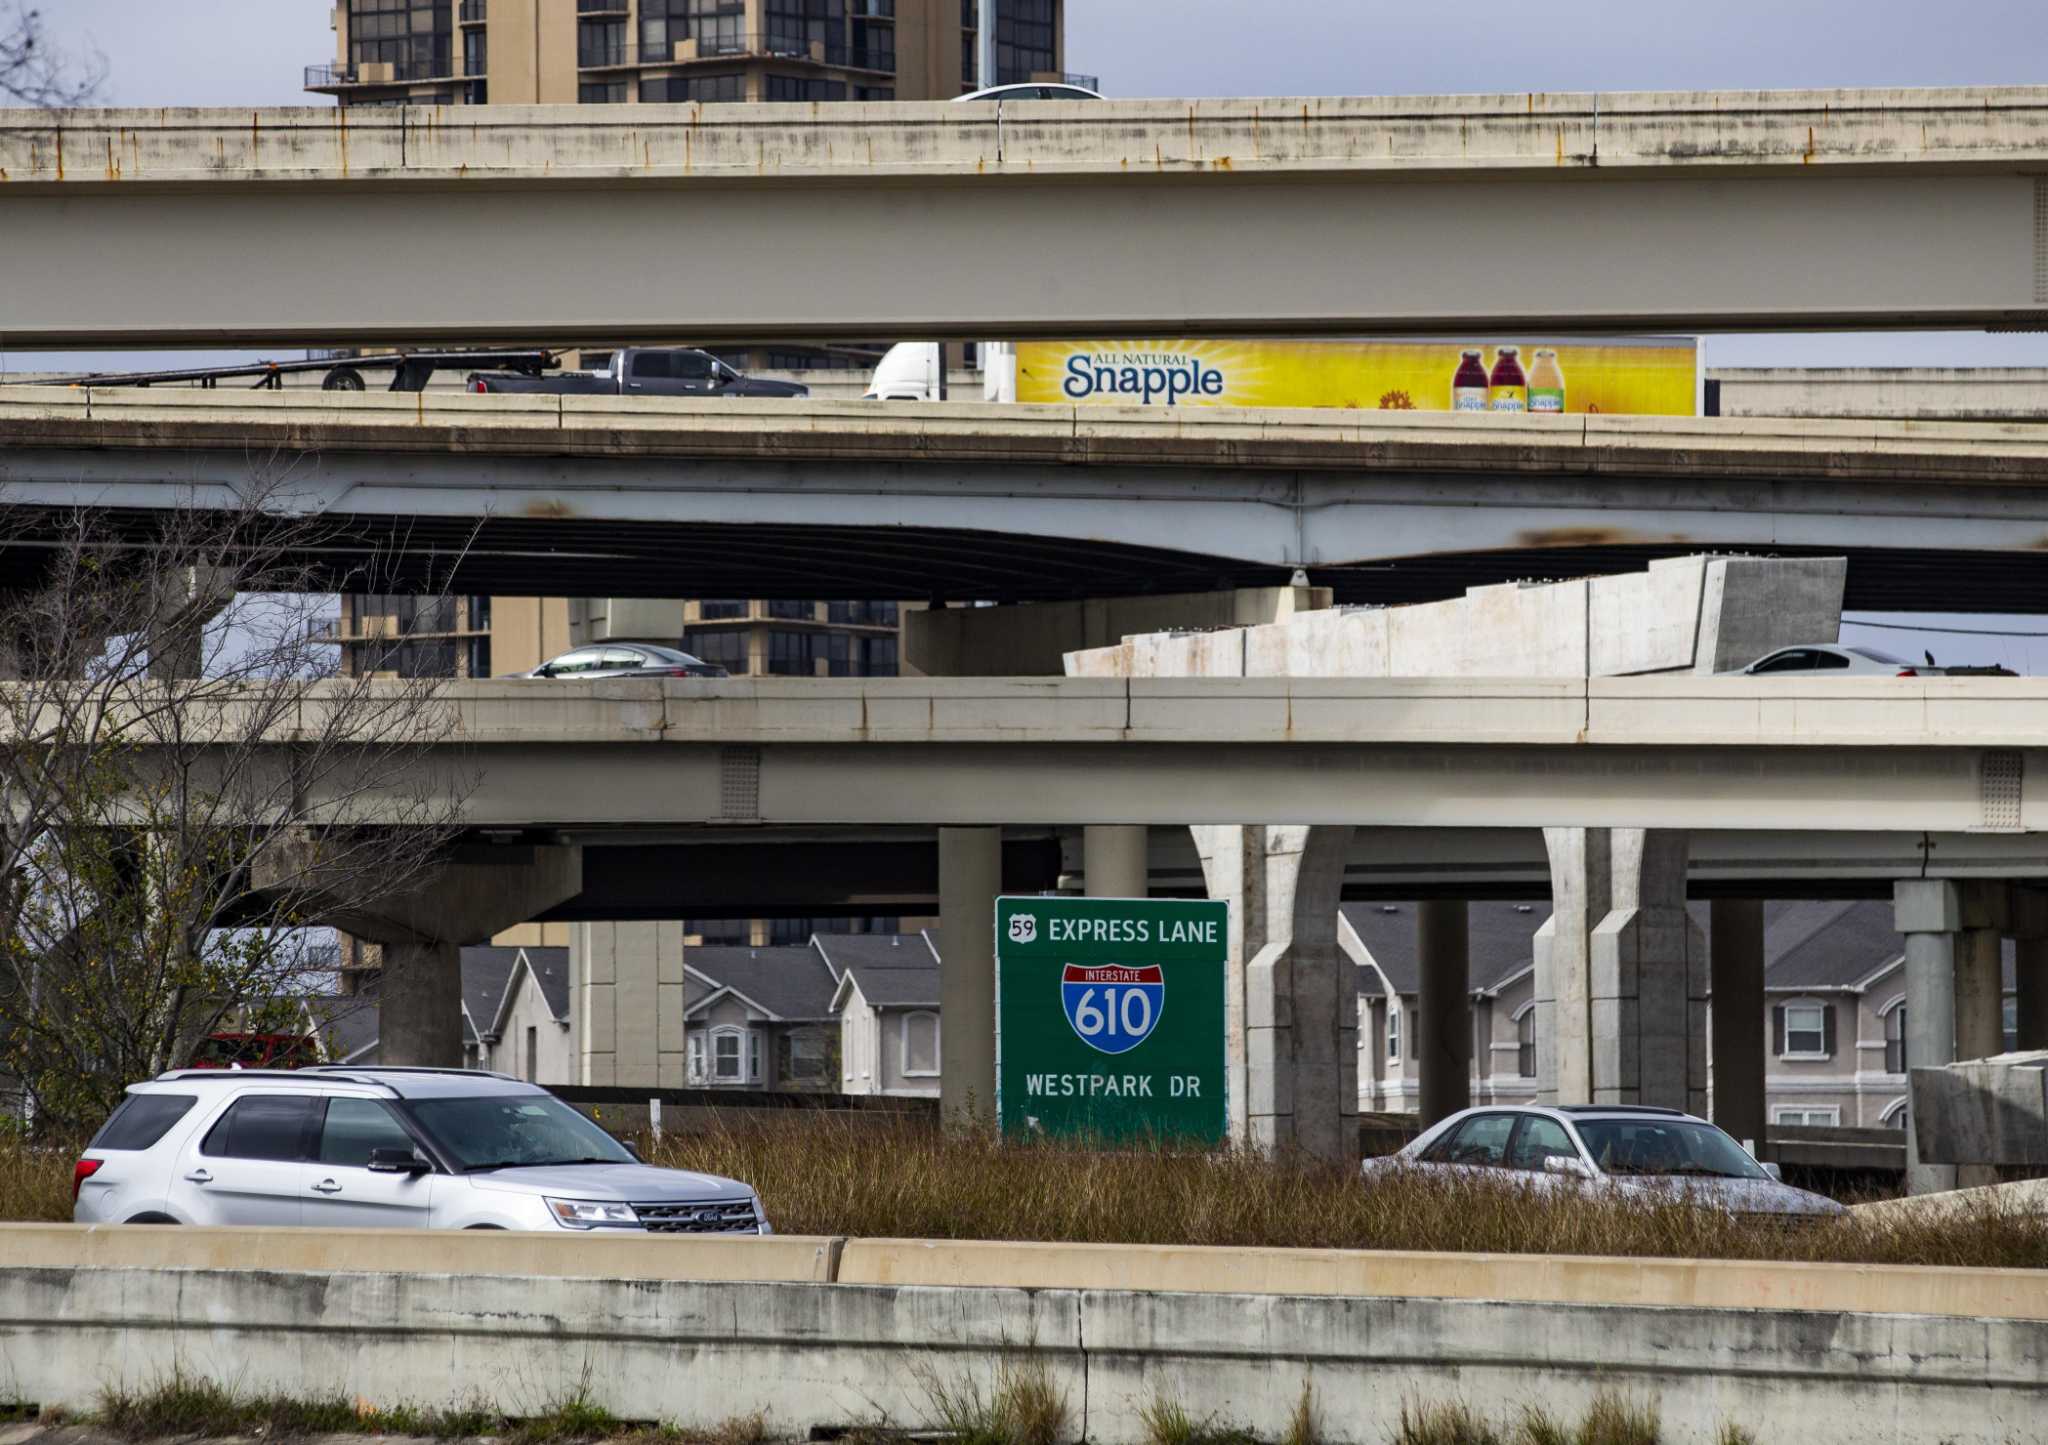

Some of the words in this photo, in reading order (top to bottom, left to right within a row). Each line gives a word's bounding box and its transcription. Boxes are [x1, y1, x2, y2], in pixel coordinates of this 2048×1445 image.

[1094, 353, 1120, 365] ALL
[1122, 354, 1189, 366] NATURAL
[1064, 355, 1223, 405] Snapple
[1012, 920, 1034, 937] 59
[1049, 919, 1149, 942] EXPRESS
[1159, 920, 1218, 943] LANE
[1085, 970, 1141, 982] INTERSTATE
[1075, 988, 1151, 1036] 610
[1026, 1074, 1153, 1097] WESTPARK
[1170, 1076, 1201, 1097] DR
